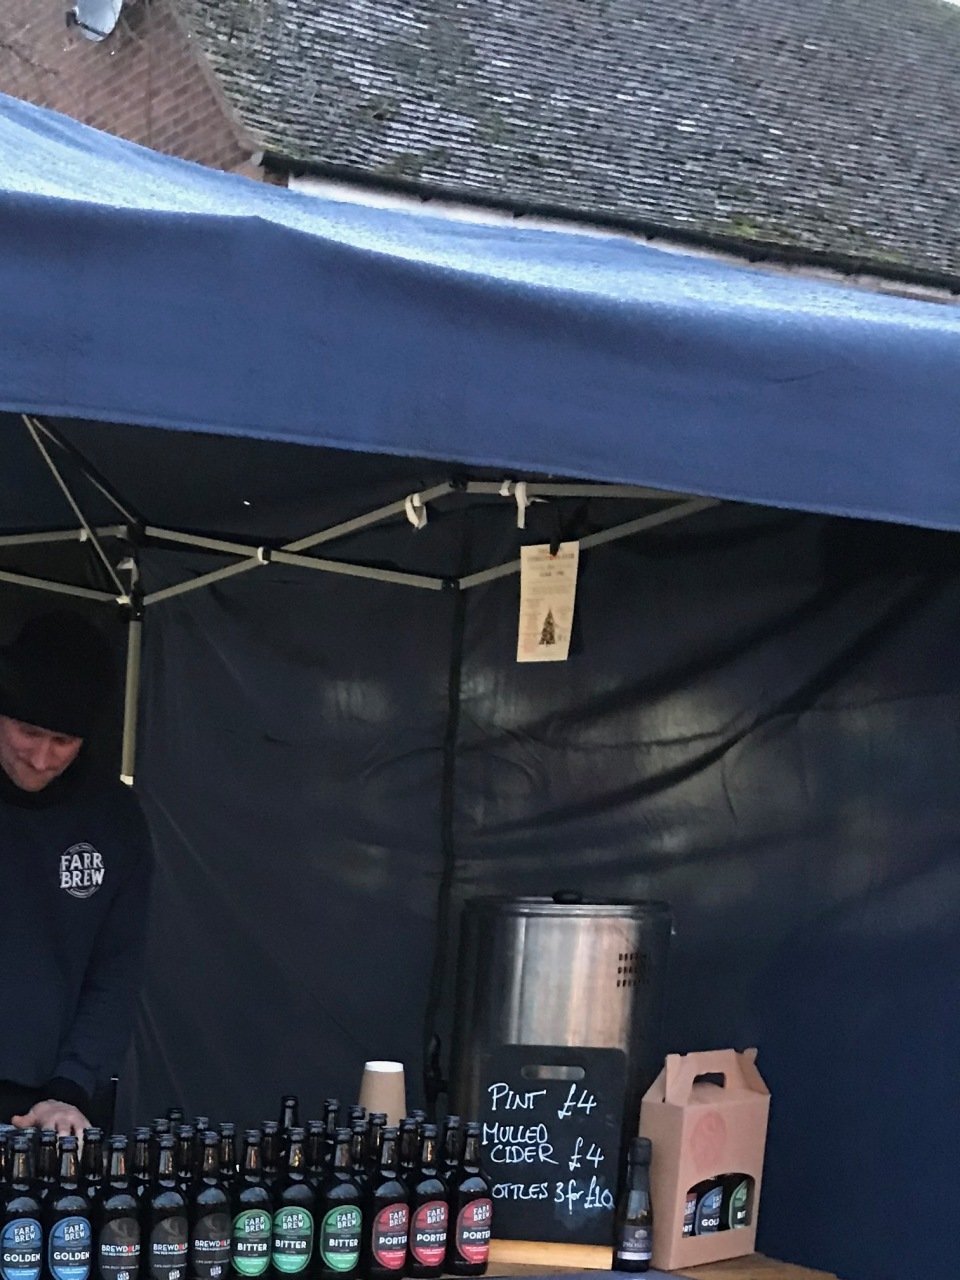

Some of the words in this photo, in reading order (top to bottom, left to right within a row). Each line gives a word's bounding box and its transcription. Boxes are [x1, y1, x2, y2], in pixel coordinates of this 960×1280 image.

[60, 852, 104, 871] FARR
[60, 868, 105, 889] BREW
[487, 1082, 547, 1111] PINT
[557, 1083, 597, 1119] £4
[482, 1122, 548, 1145] MULLED
[490, 1143, 559, 1164] CIDER
[569, 1136, 605, 1171] £4
[492, 1181, 548, 1200] OTTLES
[554, 1181, 565, 1203] 3
[584, 1175, 615, 1209] £10
[244, 1216, 264, 1226] FARR
[282, 1213, 303, 1222] FARR
[336, 1212, 356, 1222] FARR
[426, 1215, 445, 1224] BREW
[473, 1212, 490, 1221] BREW
[282, 1221, 304, 1230] BREW
[337, 1219, 356, 1229] BREW
[389, 1217, 406, 1227] BREW
[14, 1225, 35, 1235] FARR
[64, 1223, 84, 1233] FARR
[245, 1223, 265, 1233] BREW
[14, 1233, 36, 1243] BREW
[64, 1231, 85, 1241] BREW
[237, 1243, 267, 1252] BITTER
[275, 1239, 307, 1249] BITTER
[328, 1238, 358, 1247] BITTER
[3, 1252, 41, 1263] GOLDEN
[53, 1251, 90, 1261] GOLDEN
